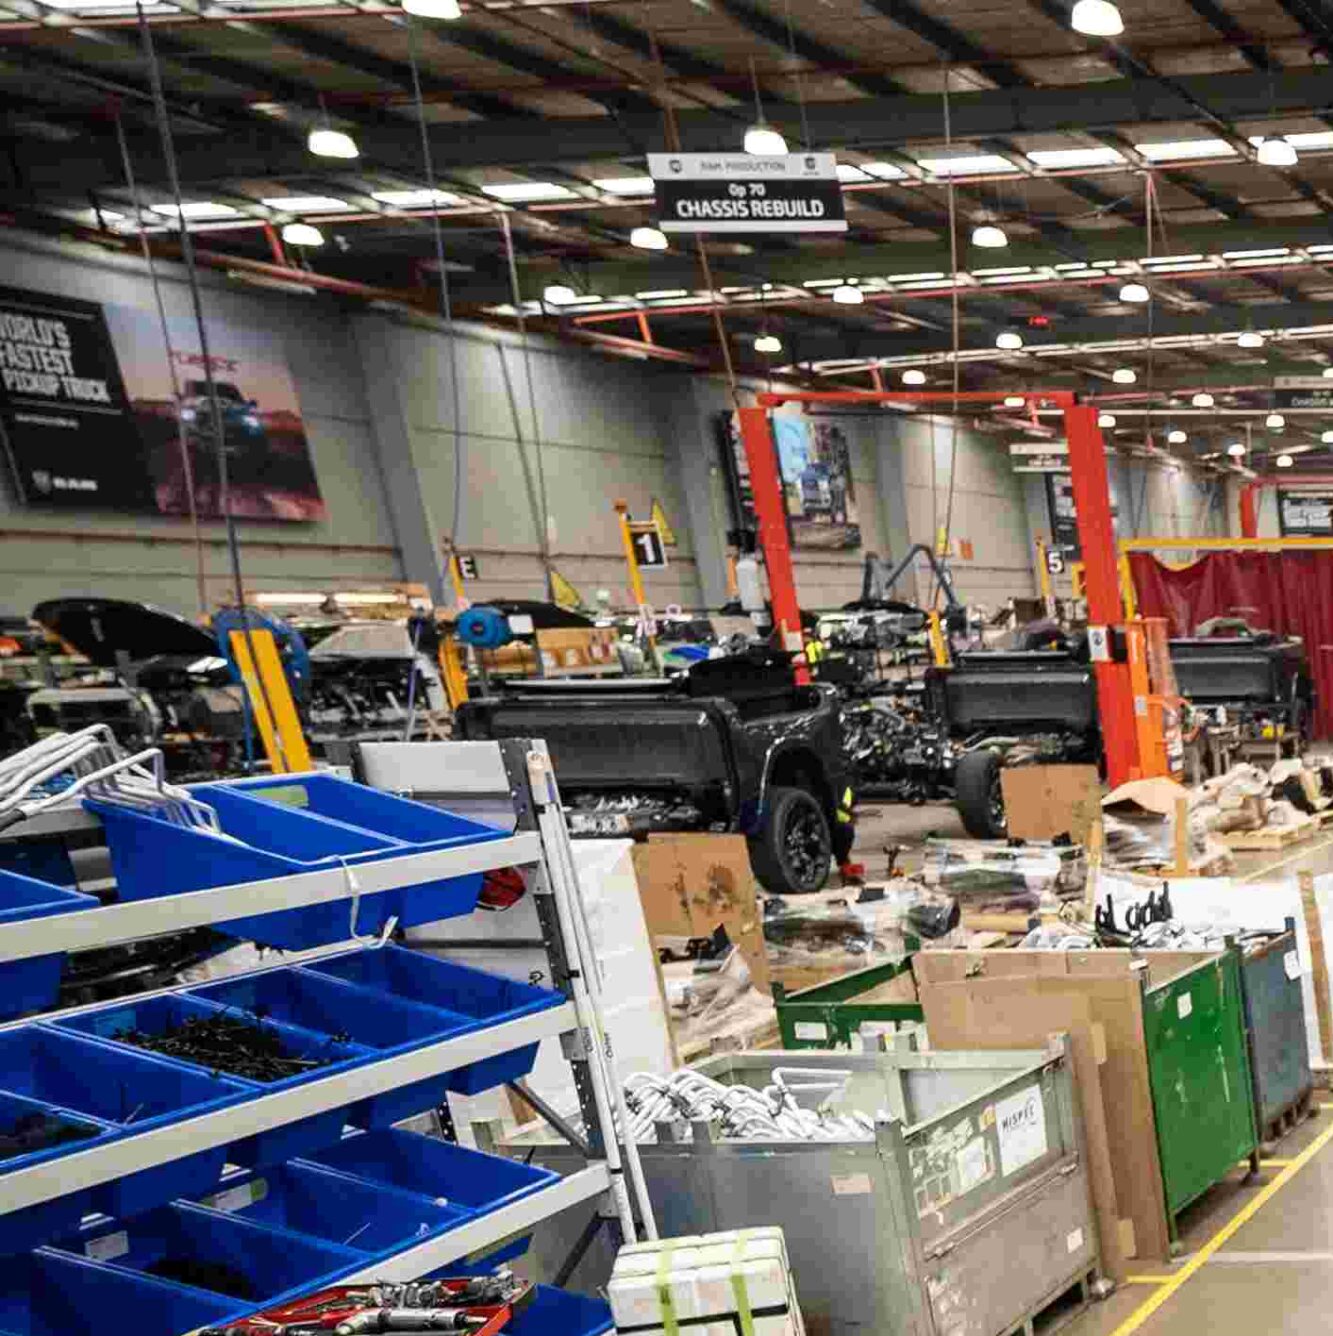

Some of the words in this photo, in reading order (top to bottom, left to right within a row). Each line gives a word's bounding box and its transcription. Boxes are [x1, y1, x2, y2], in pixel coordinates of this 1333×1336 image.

[728, 183, 747, 198] Op
[750, 183, 766, 196] 70
[676, 199, 749, 217] CHASSIS
[750, 199, 825, 217] REBUILD
[0, 313, 70, 348] ORLD'S
[0, 340, 75, 376] ASTEST
[60, 375, 112, 403] TRUCK
[637, 533, 657, 563] 1
[1049, 551, 1064, 574] 5
